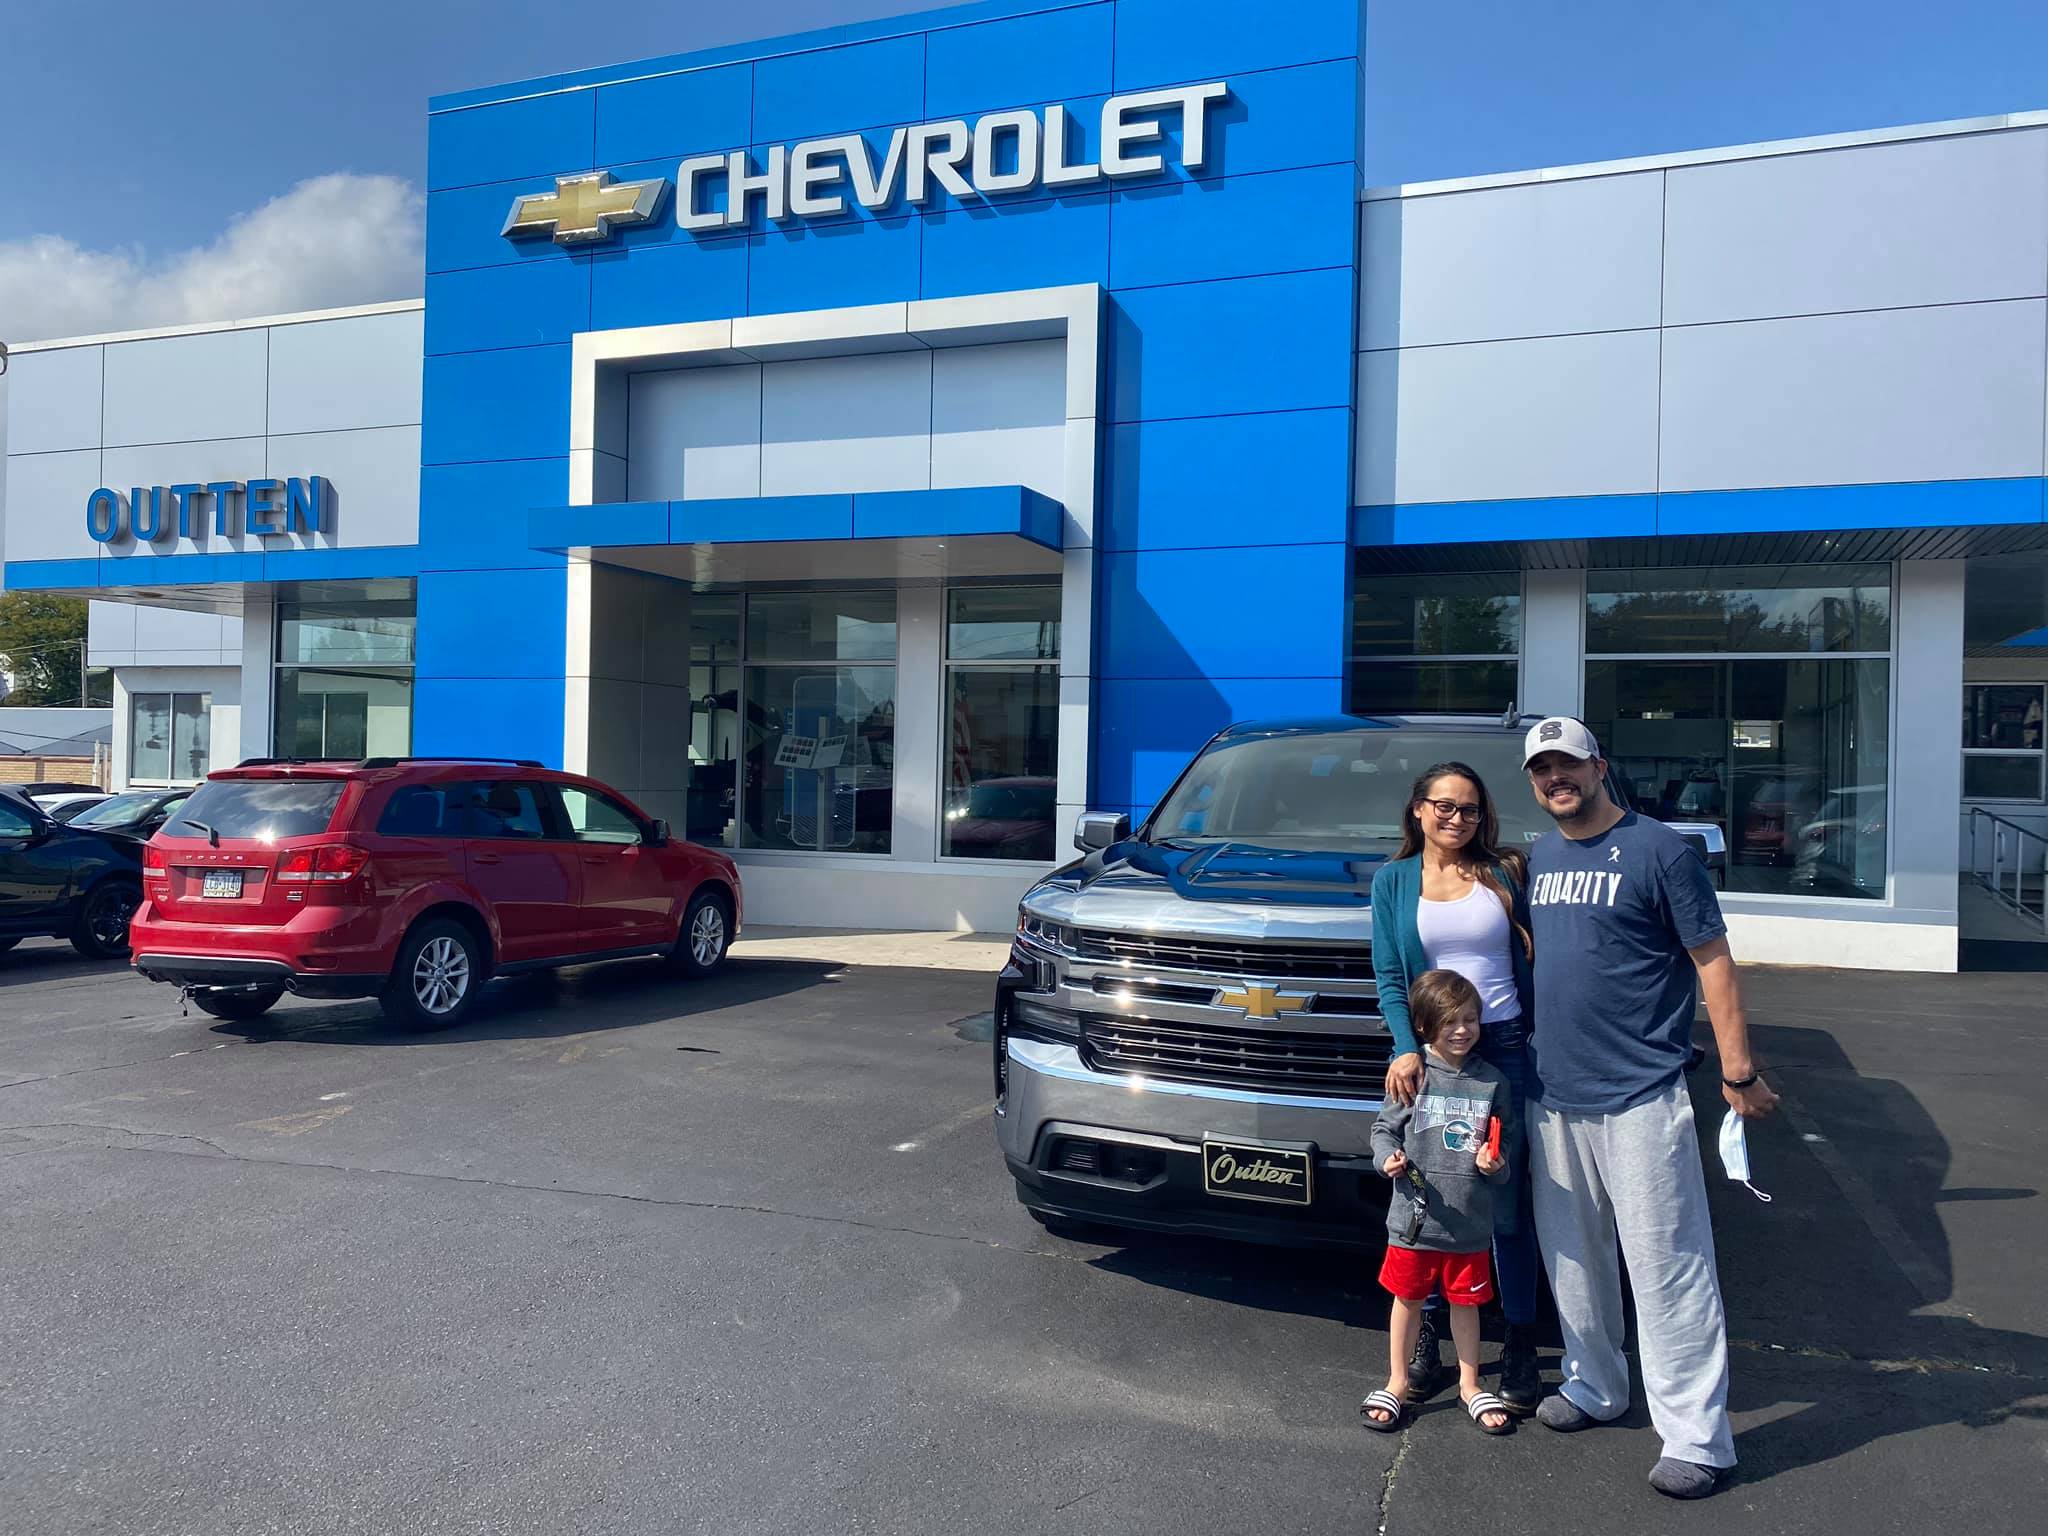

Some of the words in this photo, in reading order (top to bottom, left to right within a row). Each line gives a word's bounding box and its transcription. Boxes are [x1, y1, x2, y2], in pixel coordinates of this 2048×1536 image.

[676, 81, 1228, 232] CHEVROLET
[87, 475, 330, 544] OUTTEN
[1539, 721, 1563, 743] S
[1414, 1094, 1491, 1134] EAGLE
[1210, 1153, 1303, 1187] Outten
